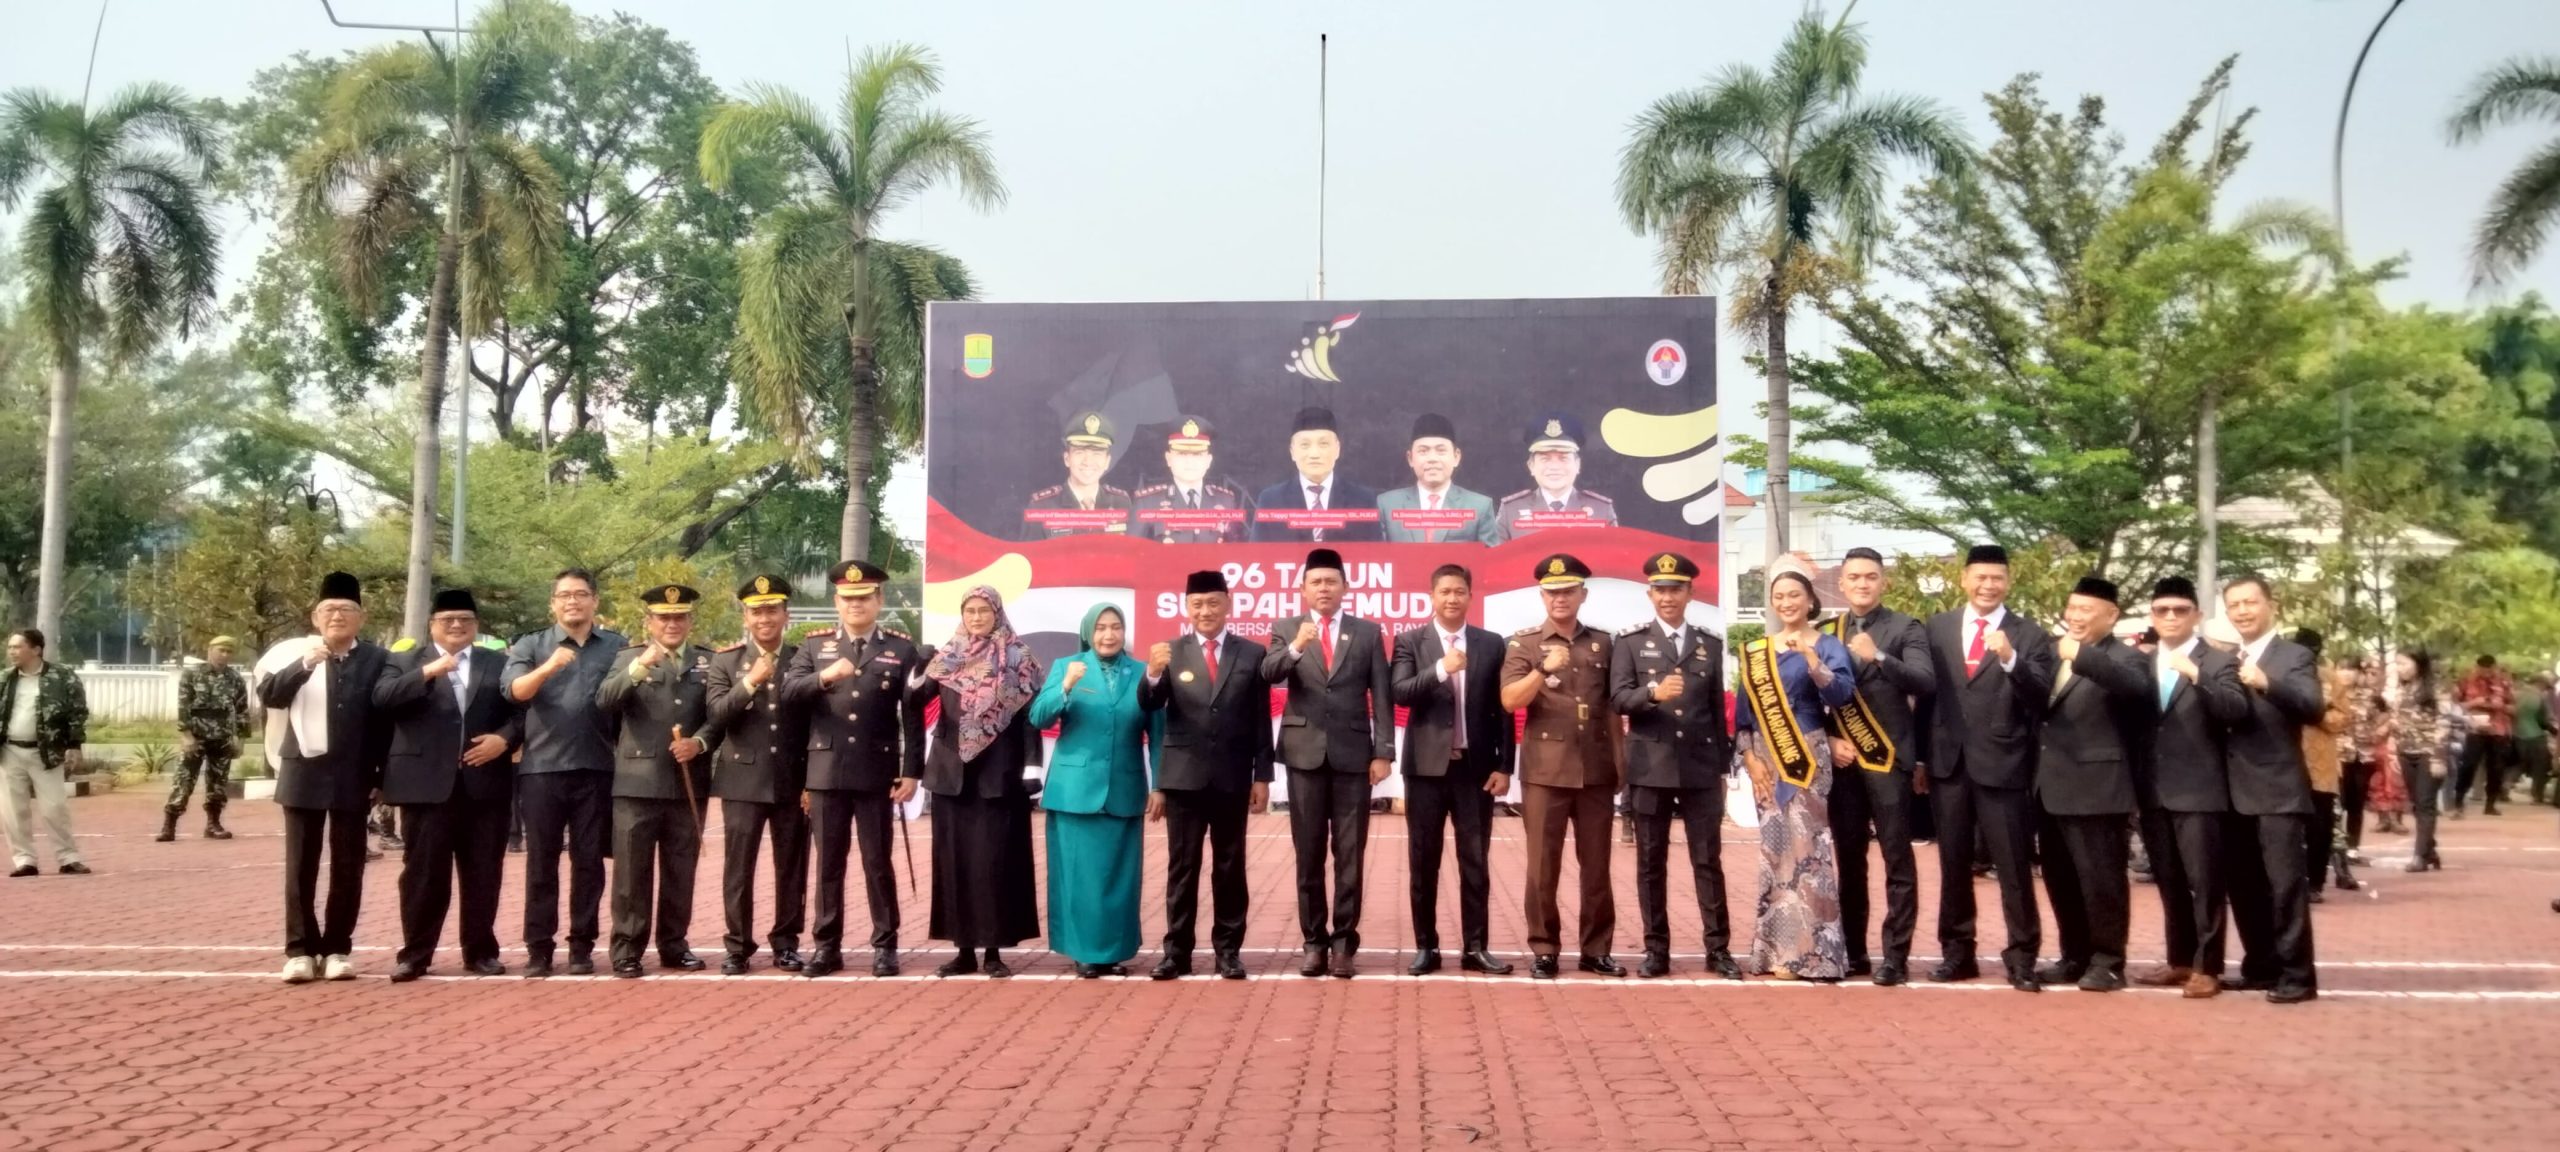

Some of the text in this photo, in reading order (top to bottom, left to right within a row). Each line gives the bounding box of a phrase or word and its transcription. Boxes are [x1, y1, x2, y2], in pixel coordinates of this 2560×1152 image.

[1220, 562, 1392, 589] 96 TAUN
[1156, 592, 1433, 619] SPAH EMUD
[1226, 622, 1273, 636] BERSA
[1757, 682, 1778, 709] KAB.
[1765, 706, 1800, 764] KARAWANG
[1840, 703, 1878, 753] ARAWANG
